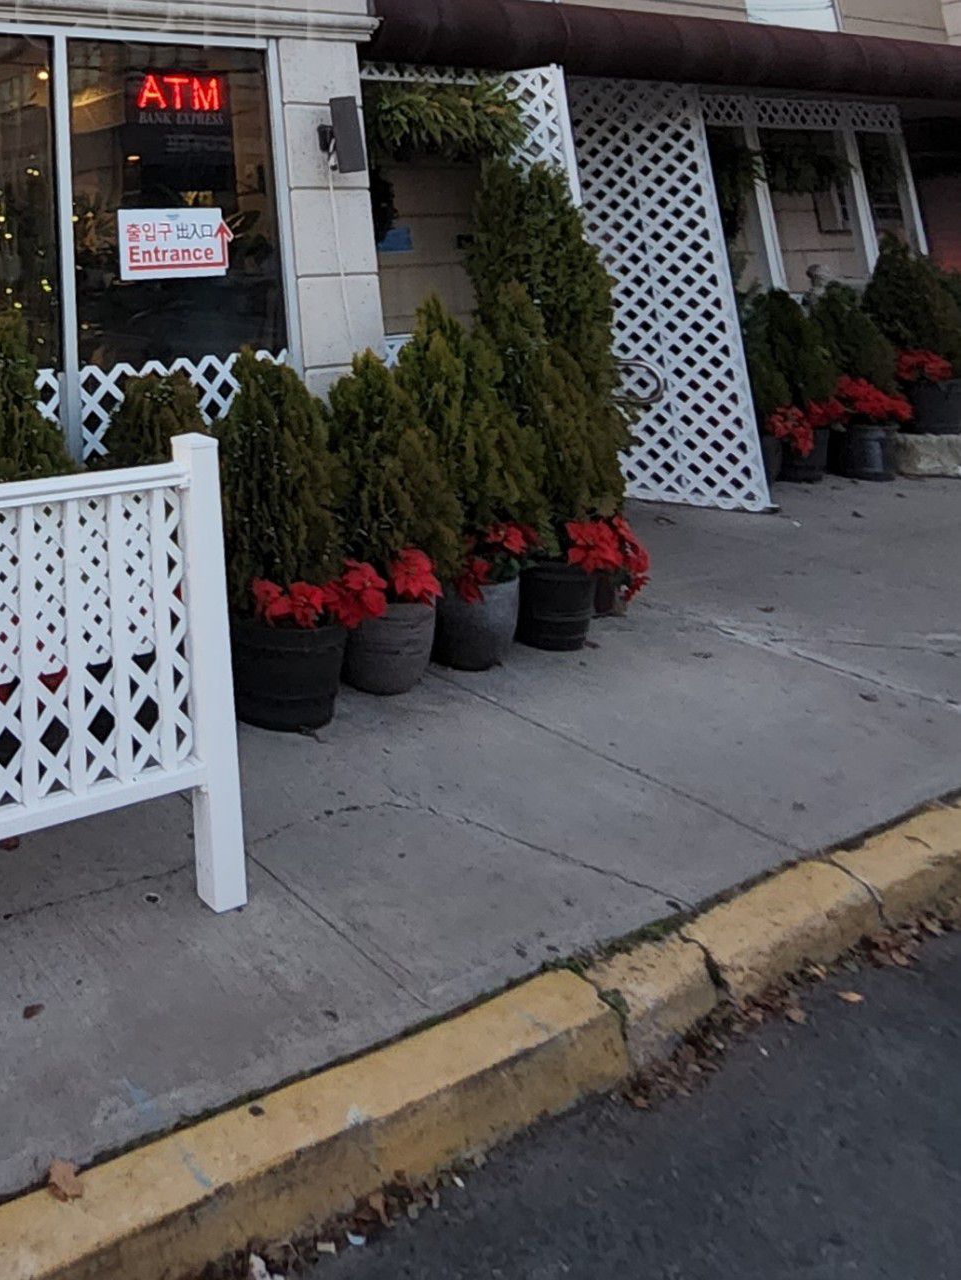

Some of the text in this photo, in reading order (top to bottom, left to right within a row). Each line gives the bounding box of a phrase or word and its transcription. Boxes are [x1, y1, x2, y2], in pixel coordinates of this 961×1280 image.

[138, 74, 222, 111] ATM
[126, 222, 213, 242] 출입구 出入口
[128, 245, 214, 264] Entrance
